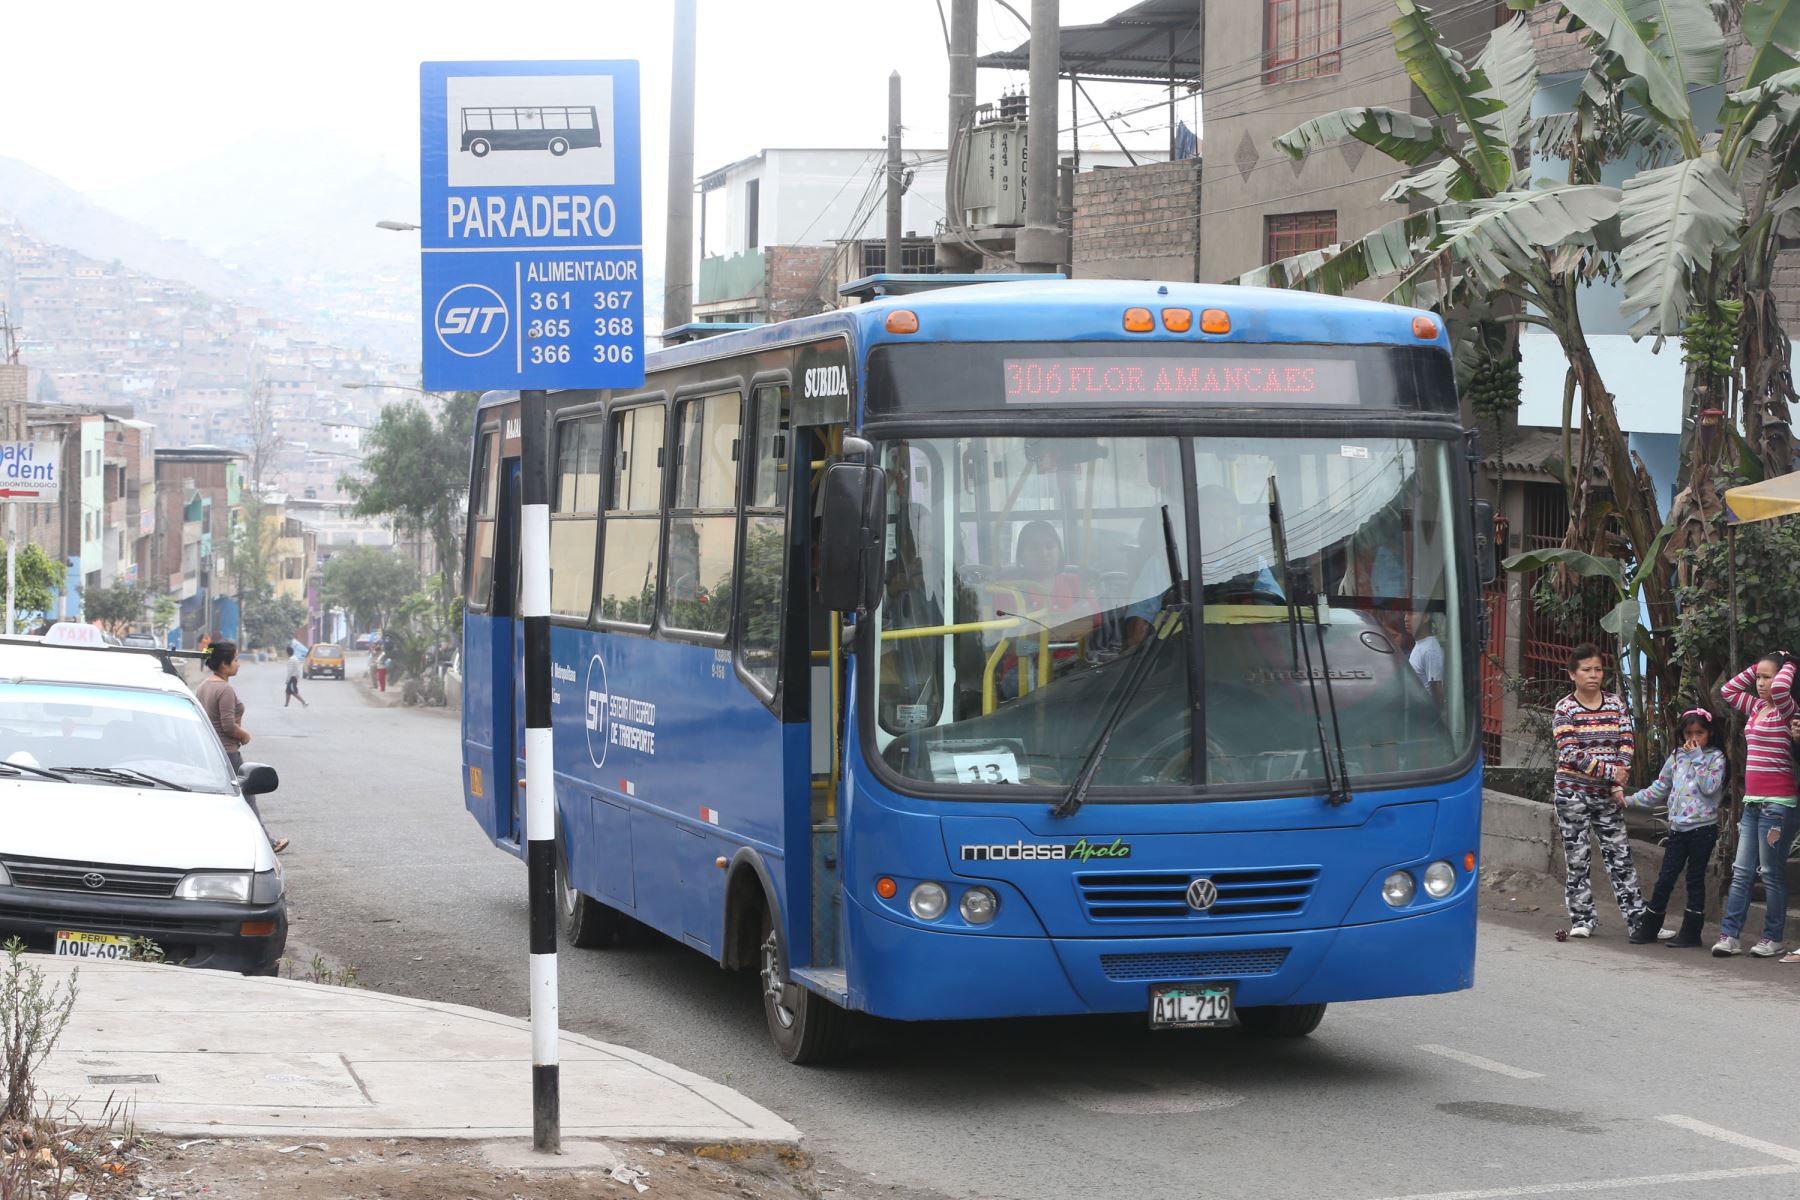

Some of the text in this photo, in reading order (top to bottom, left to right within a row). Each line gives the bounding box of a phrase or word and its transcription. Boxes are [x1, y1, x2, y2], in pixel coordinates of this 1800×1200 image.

[447, 194, 616, 238] PARADERO
[527, 261, 638, 282] ALIMENTADOR
[530, 291, 633, 310] 361 367
[440, 307, 505, 334] SIT
[530, 317, 634, 338] 365 368
[531, 344, 634, 364] 366 306
[804, 365, 848, 398] SUBIDA
[1007, 364, 1316, 395] 306 FLOR AMANCAES
[7, 463, 54, 480] dent
[57, 627, 96, 642] TAXI
[610, 722, 655, 755] DE TRANSPORTE
[968, 763, 1003, 783] 13
[961, 838, 1130, 864] modasa Apolo
[80, 933, 108, 943] PERU
[1156, 995, 1229, 1022] A1L-719
